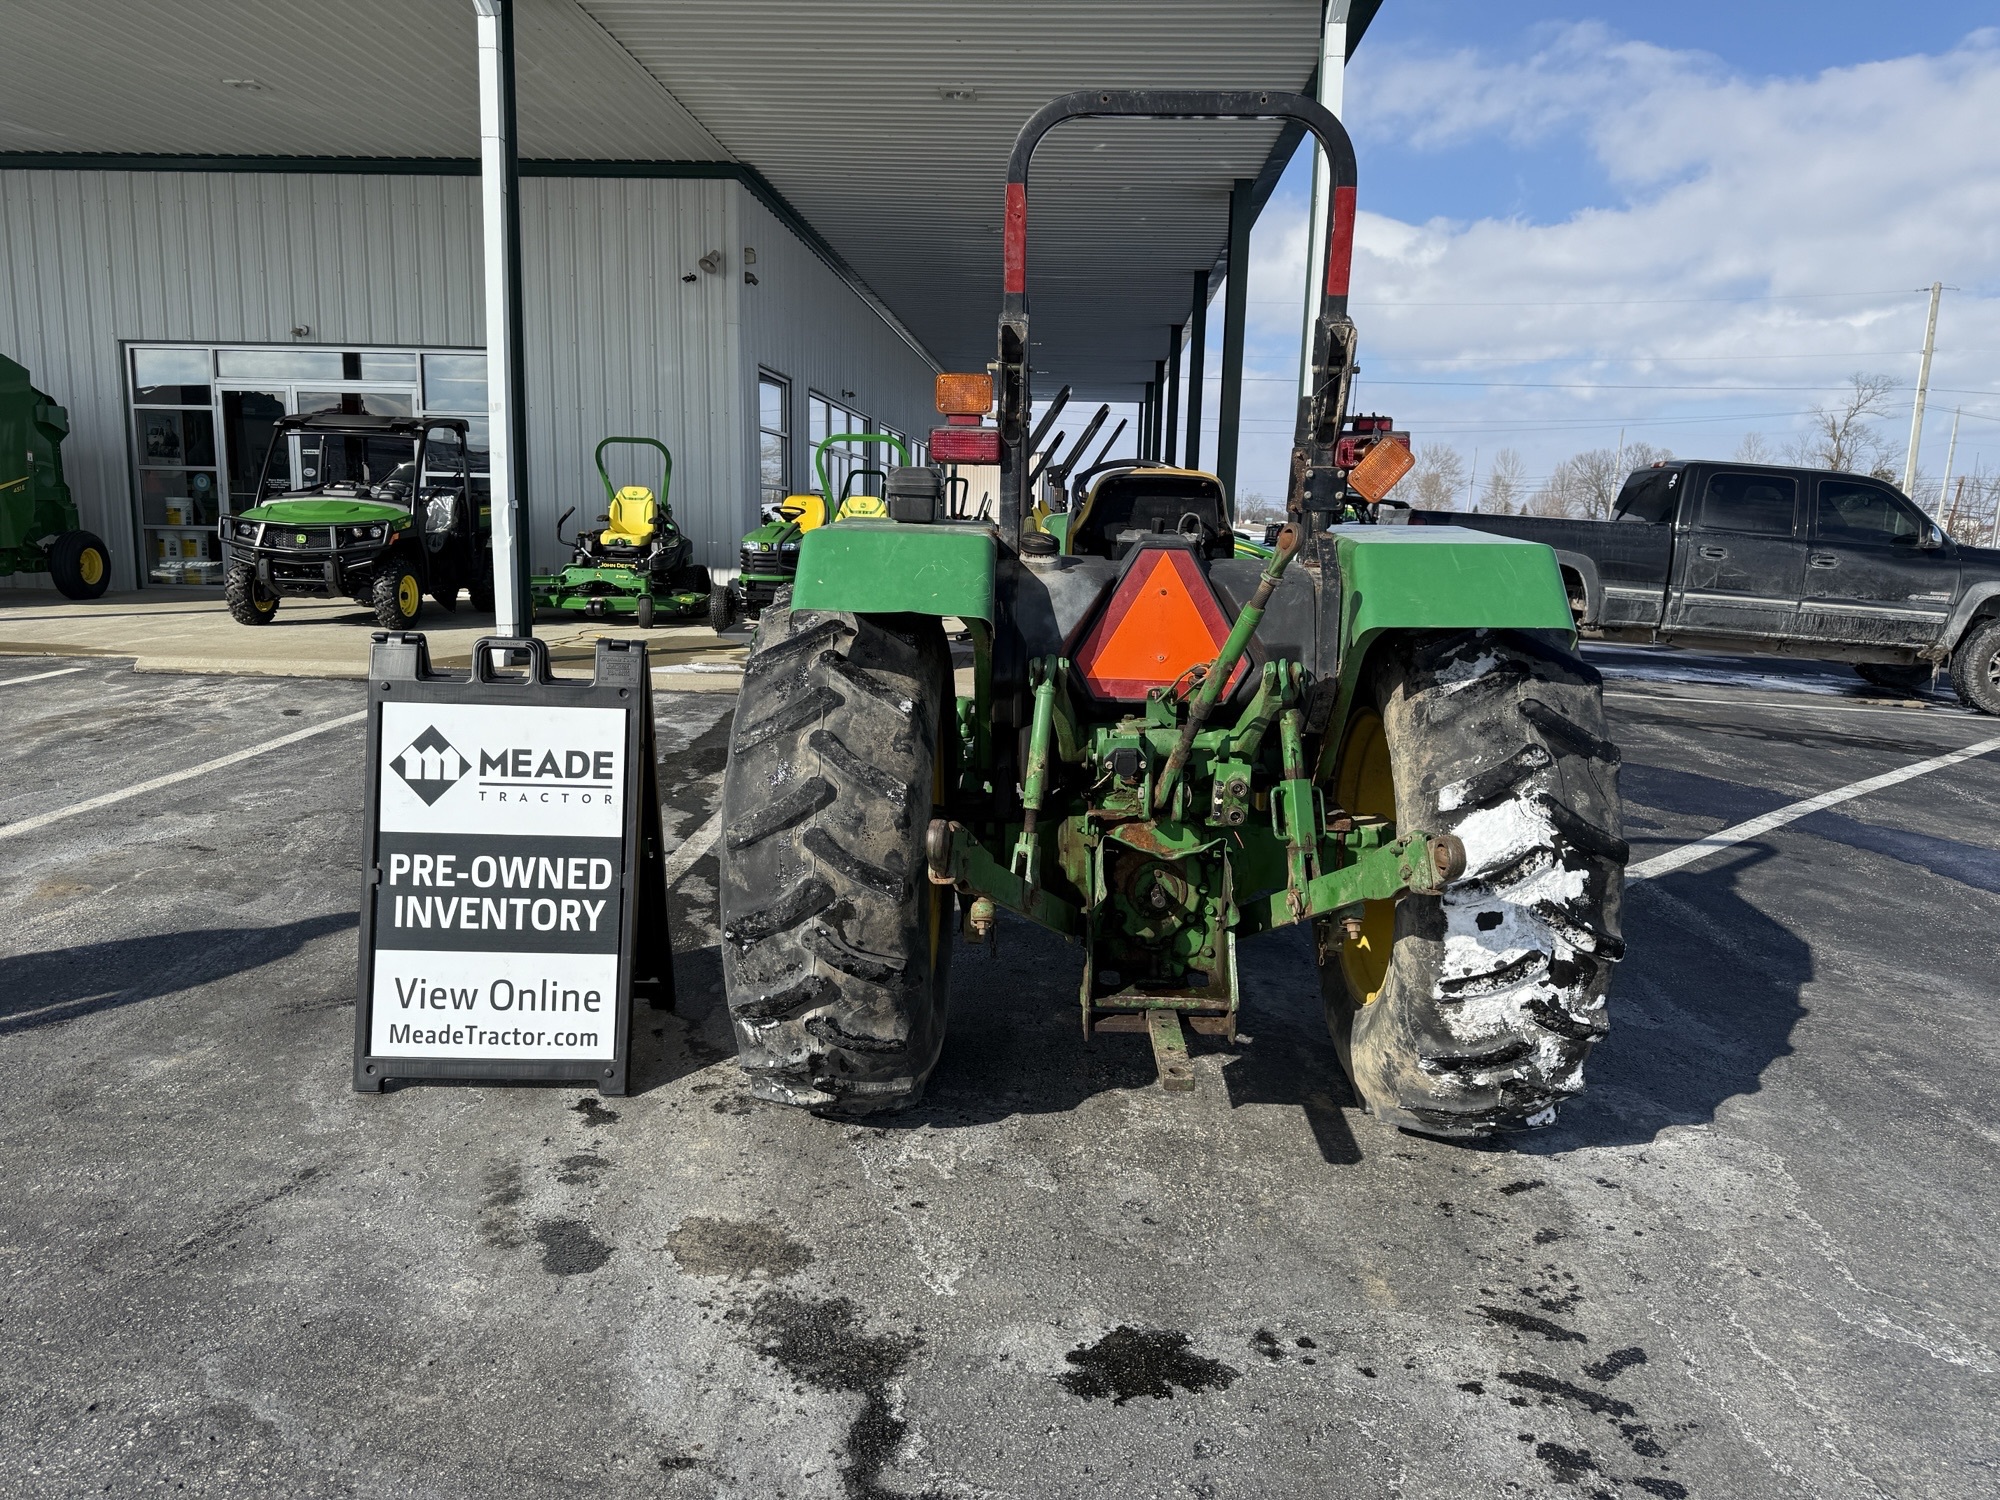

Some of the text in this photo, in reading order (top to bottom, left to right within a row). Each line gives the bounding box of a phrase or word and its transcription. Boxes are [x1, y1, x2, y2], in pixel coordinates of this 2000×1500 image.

[479, 747, 614, 780] MEADE
[478, 791, 613, 805] TRACTOR
[389, 853, 613, 890] PRE-OWNED
[394, 895, 607, 932] INVENTORY
[394, 977, 601, 1013] View Online
[389, 1023, 598, 1047] MeadeTractor.com
